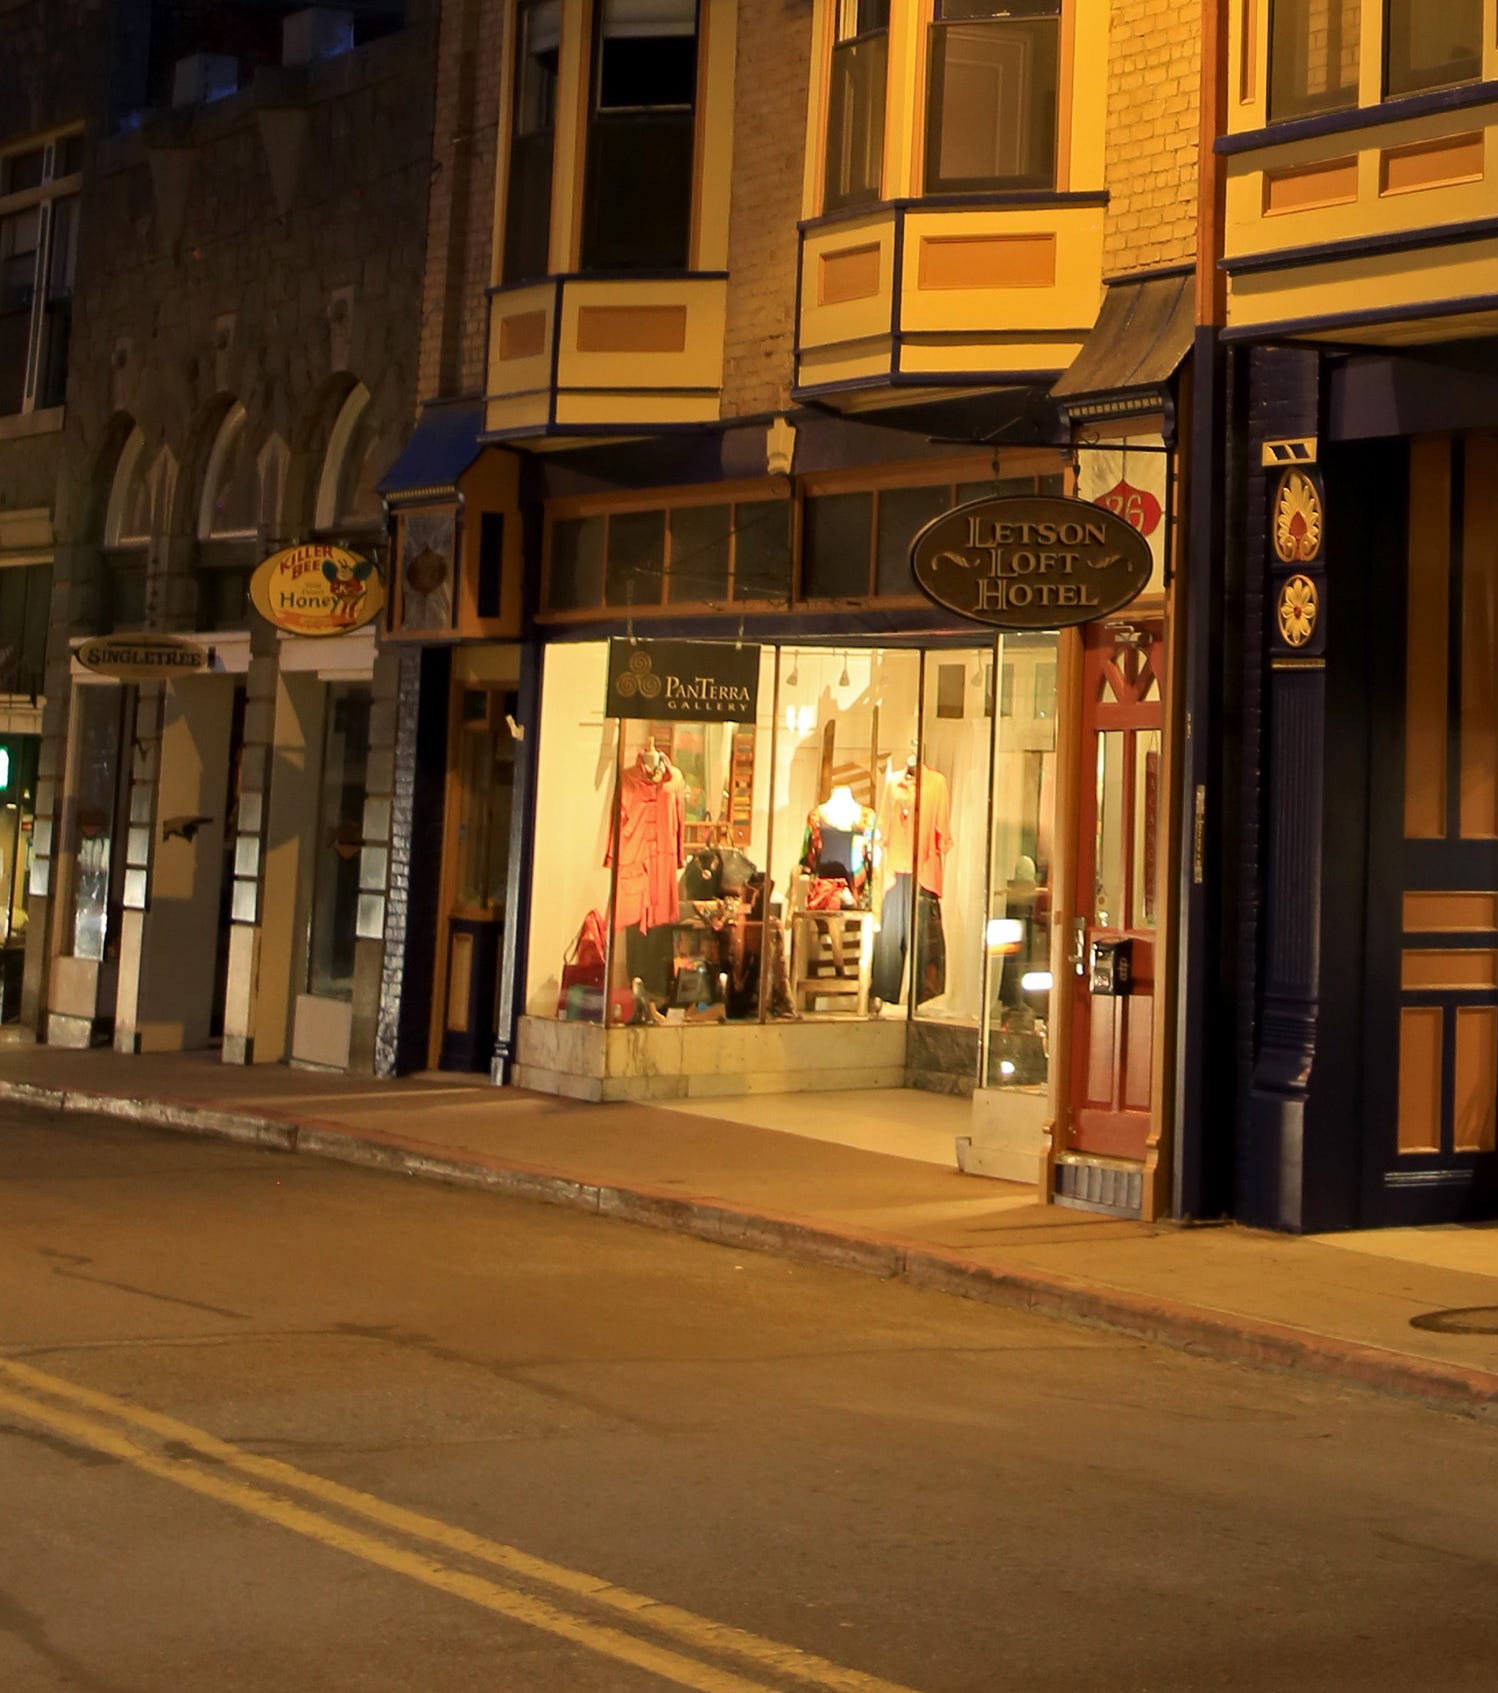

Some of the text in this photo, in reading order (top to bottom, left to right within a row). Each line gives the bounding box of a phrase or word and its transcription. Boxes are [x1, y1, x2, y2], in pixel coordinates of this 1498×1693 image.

[966, 517, 1107, 548] LETSON
[280, 545, 334, 575] KILLER
[291, 559, 321, 580] BEE
[989, 549, 1080, 577] LOFT
[280, 592, 339, 614] Honey
[972, 579, 1099, 611] HOTEL
[87, 647, 201, 667] SINGLETREE
[665, 676, 750, 701] PANTERRA
[668, 701, 748, 711] GALLERY
